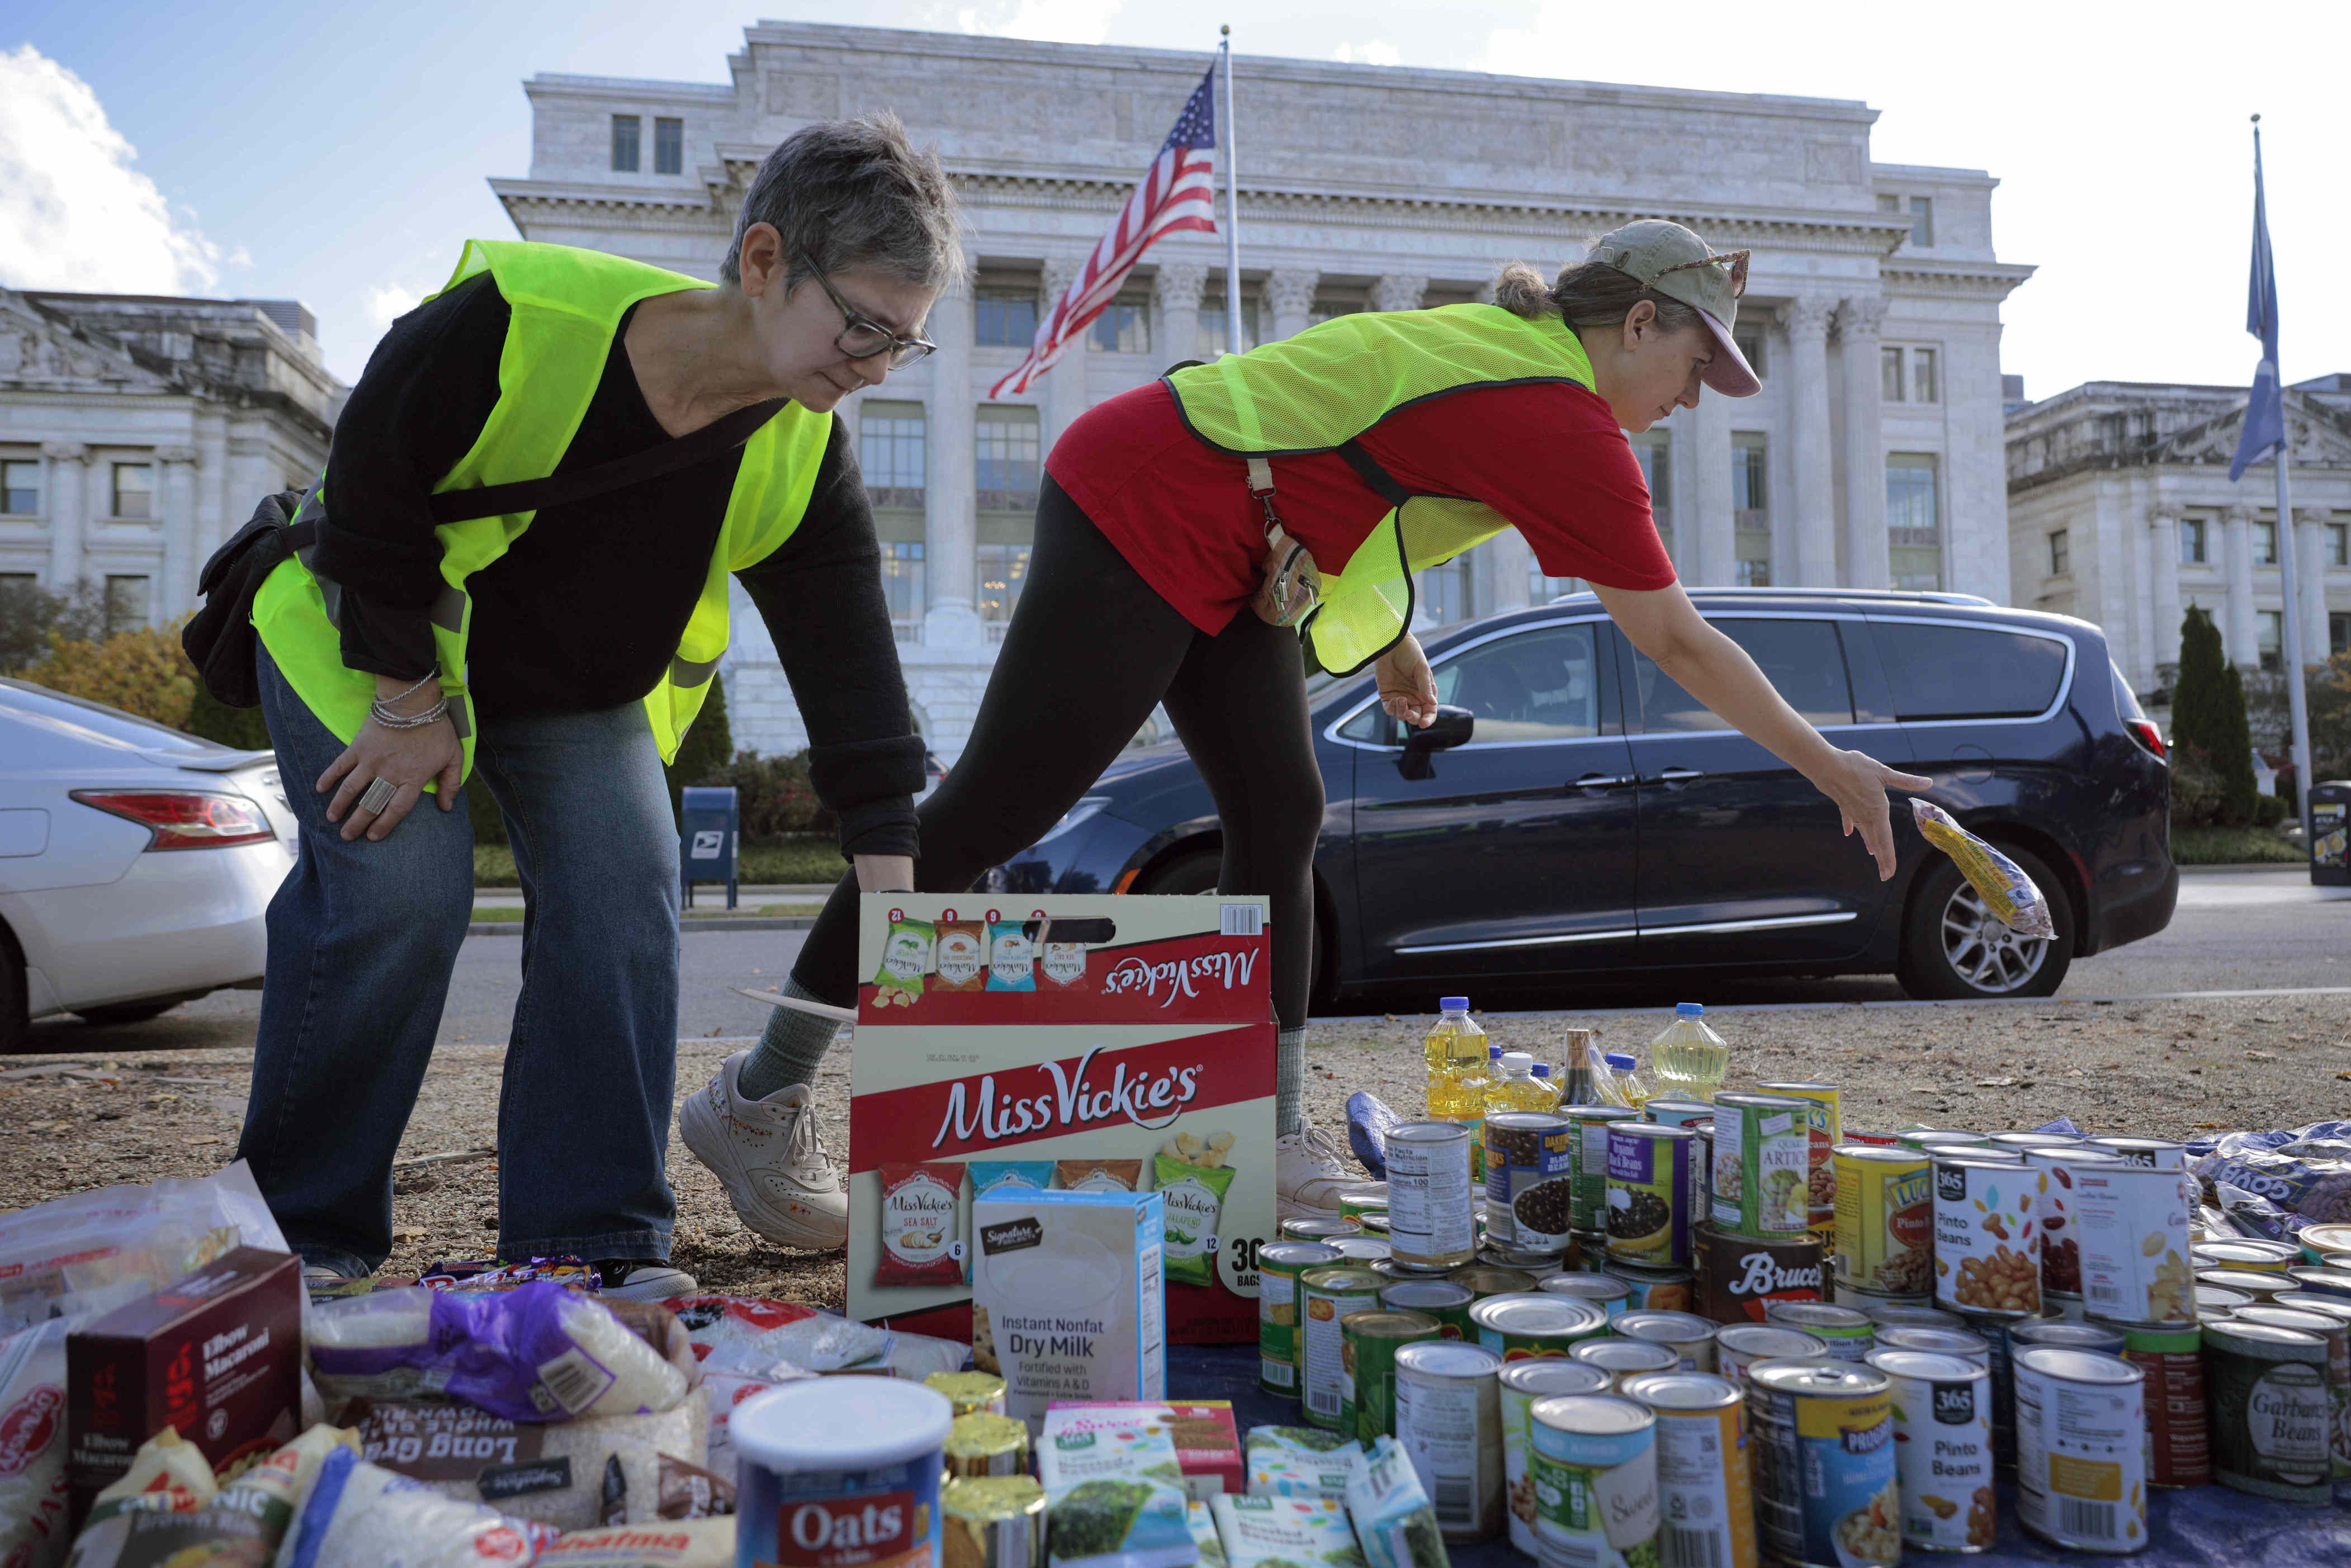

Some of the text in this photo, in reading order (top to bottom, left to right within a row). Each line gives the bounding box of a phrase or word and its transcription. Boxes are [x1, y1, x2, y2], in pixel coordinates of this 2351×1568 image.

[891, 910, 901, 921] 12
[1105, 948, 1260, 1008] Miss Vickie's
[932, 1043, 1197, 1148] Miss Vickie's
[2219, 1164, 2290, 1200] GOYA
[889, 1192, 953, 1215] Miss Vickie's
[1182, 1193, 1217, 1217] Vickie's
[903, 1217, 938, 1227] SEA SALT
[1937, 1211, 1968, 1229] Pinto
[1206, 1238, 1217, 1249] 12
[1937, 1228, 1972, 1246] Beans
[954, 1244, 961, 1256] 6
[1231, 1237, 1266, 1272] 30
[1237, 1275, 1260, 1287] BAGS
[1002, 1316, 1104, 1334] Instant Nonfat
[1010, 1333, 1094, 1358] Dry Milk
[1019, 1361, 1087, 1376] Fortified with
[1016, 1376, 1090, 1391] Vitamins A & D
[2272, 1417, 2321, 1441] Beans
[363, 1431, 518, 1465] Long Gra
[1934, 1439, 1978, 1457] Pinto
[1932, 1460, 1980, 1476] Beans
[791, 1503, 903, 1551] Oats
